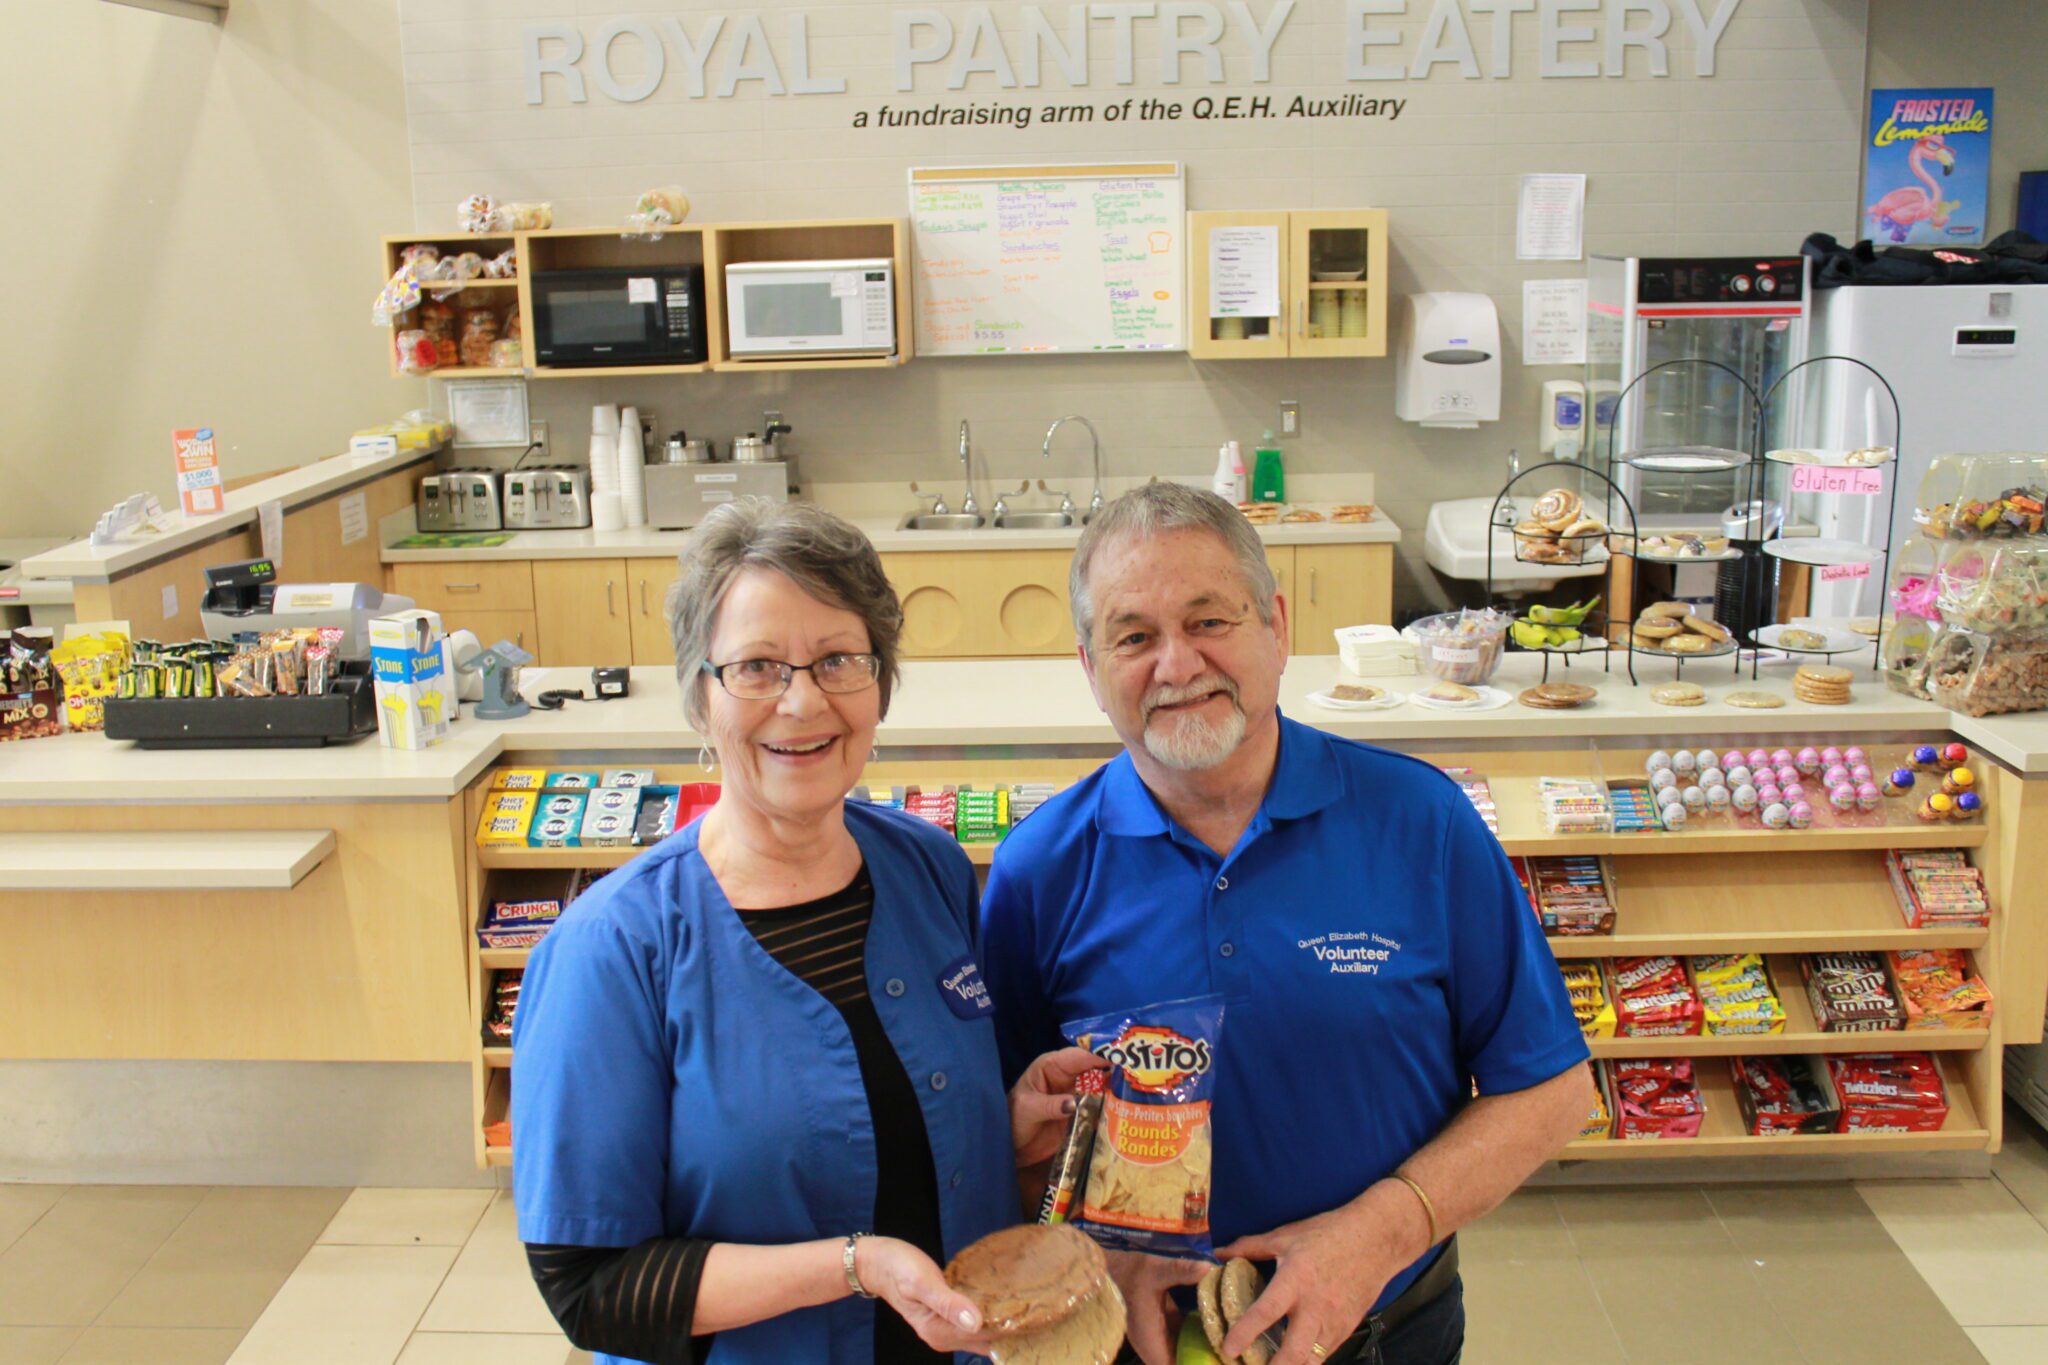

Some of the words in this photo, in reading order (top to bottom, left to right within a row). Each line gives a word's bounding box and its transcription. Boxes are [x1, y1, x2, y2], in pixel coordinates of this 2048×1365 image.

[522, 12, 847, 105] ROYAL
[896, 0, 1298, 92] PANTRY
[1346, 0, 1742, 81] EATERY
[852, 108, 869, 129] a
[878, 101, 1031, 132] fundraising
[1040, 103, 1093, 124] arm
[1103, 99, 1135, 122] of
[1140, 98, 1183, 121] the
[1192, 96, 1277, 120] Q.E.H.
[1286, 94, 1407, 120] Auxiliary
[1892, 98, 1975, 123] FROSTED
[1873, 110, 1989, 147] Lemonade
[1792, 466, 1847, 491] Gluten
[1853, 469, 1880, 492] Free
[375, 657, 404, 674] STONE
[412, 653, 440, 672] STONE
[3, 707, 29, 725] MIX
[507, 773, 532, 781] Juicy
[497, 803, 522, 812] Fruit
[499, 795, 524, 804] Juicy
[490, 824, 516, 833] Fruit
[493, 816, 518, 826] Juicy
[498, 903, 558, 918] CRUNCH
[490, 934, 545, 947] CRUNC
[1297, 935, 1326, 949] Queen
[1329, 931, 1369, 941] Elizabeth
[1371, 933, 1402, 952] Hospital
[1313, 945, 1391, 961] Volunteer
[1330, 962, 1379, 976] Auxiliary
[1616, 956, 1677, 988] Skittles
[1626, 991, 1692, 1010] Skittles
[1842, 1080, 1898, 1096] Twizzlers
[1135, 1106, 1165, 1121] Petites
[1119, 1118, 1180, 1140] Rounds
[1118, 1135, 1178, 1158] Rondes
